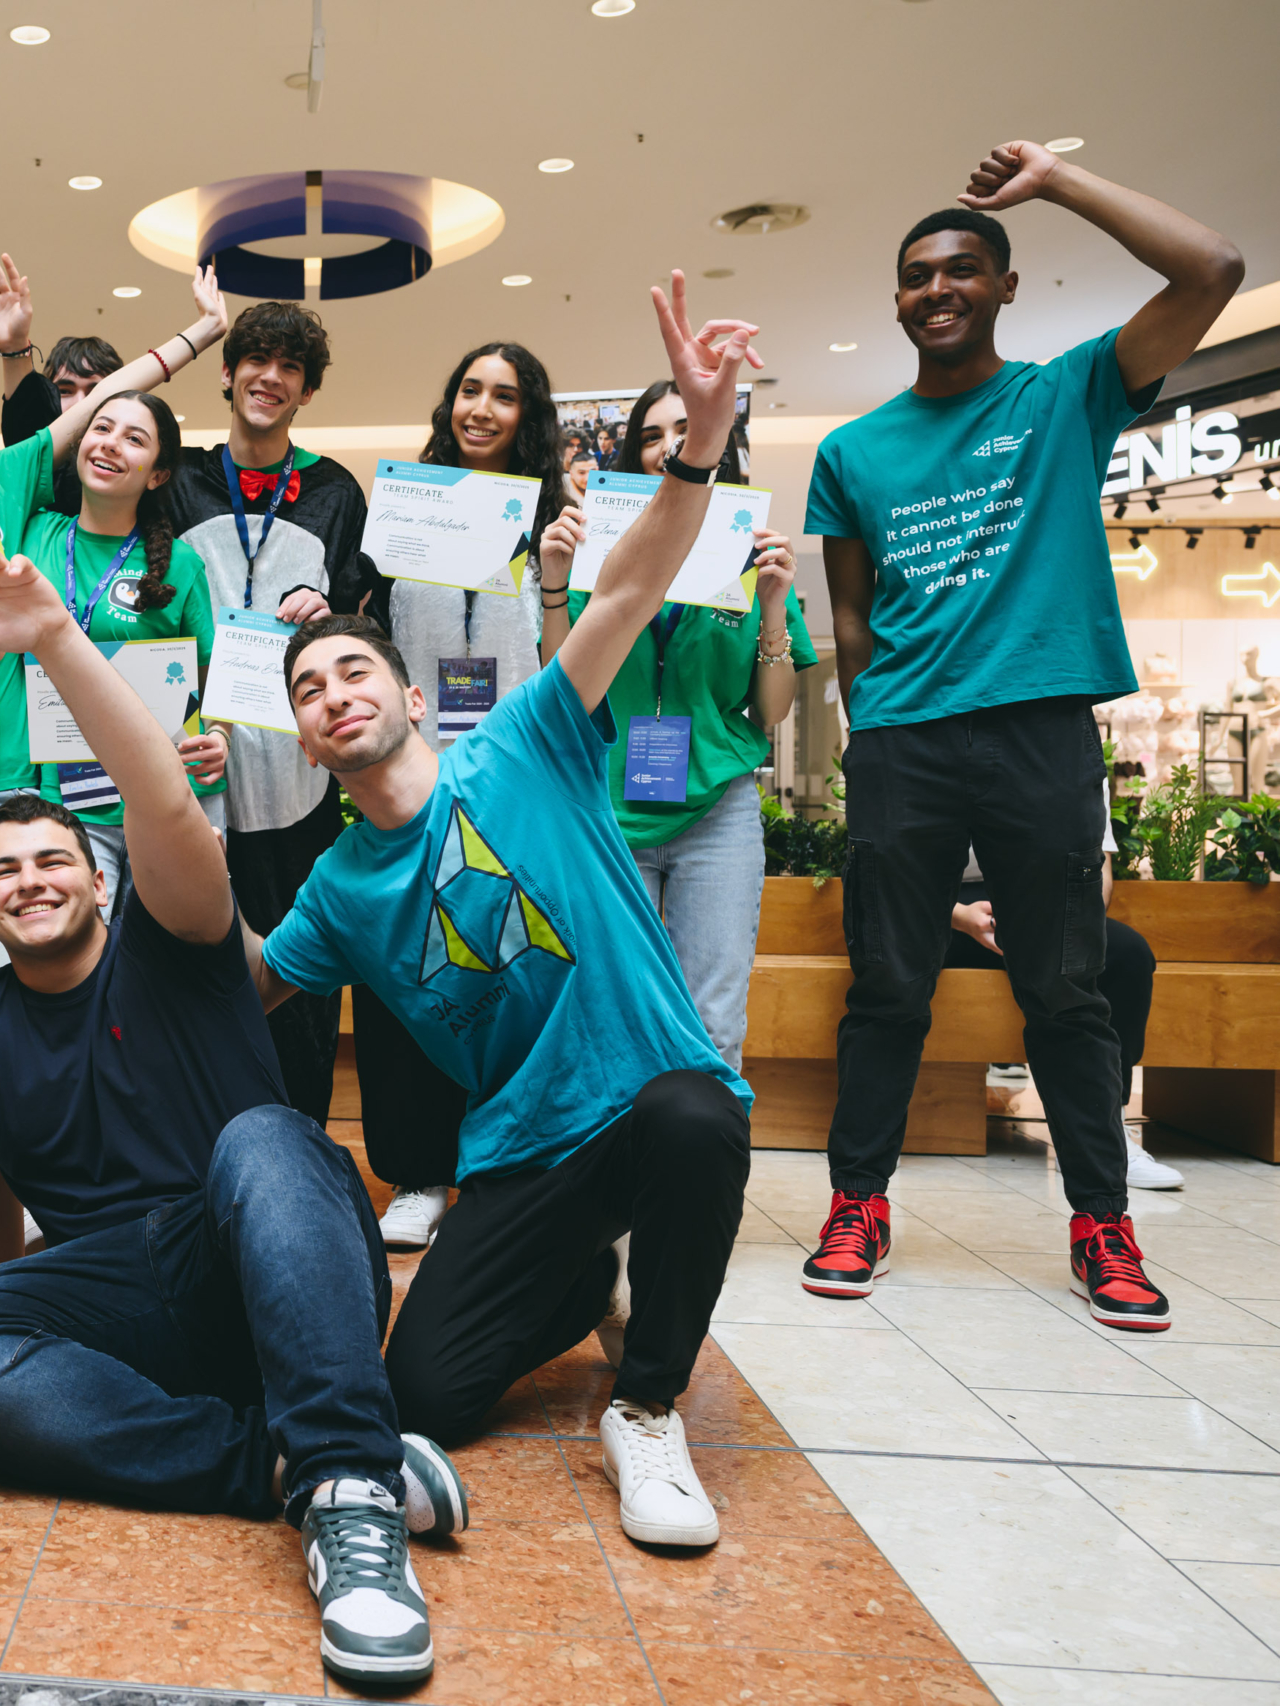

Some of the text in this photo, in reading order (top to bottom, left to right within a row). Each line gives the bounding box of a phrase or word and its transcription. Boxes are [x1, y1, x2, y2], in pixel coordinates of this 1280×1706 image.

[994, 445, 1019, 453] Cyprus
[382, 483, 444, 499] CERTIFICATE
[891, 476, 1015, 519] People who say
[594, 495, 649, 509] CERTIFICA
[887, 496, 1024, 542] it cannot be done
[882, 541, 932, 566] should
[936, 534, 963, 550] not
[904, 541, 1010, 579] those who are
[925, 567, 991, 595] doing it.
[106, 605, 138, 623] Team
[710, 610, 739, 628] Team
[225, 630, 286, 648] CERTIFICATE
[446, 676, 472, 685] TRADE
[430, 998, 460, 1021] JA
[448, 976, 511, 1038] Alumni
